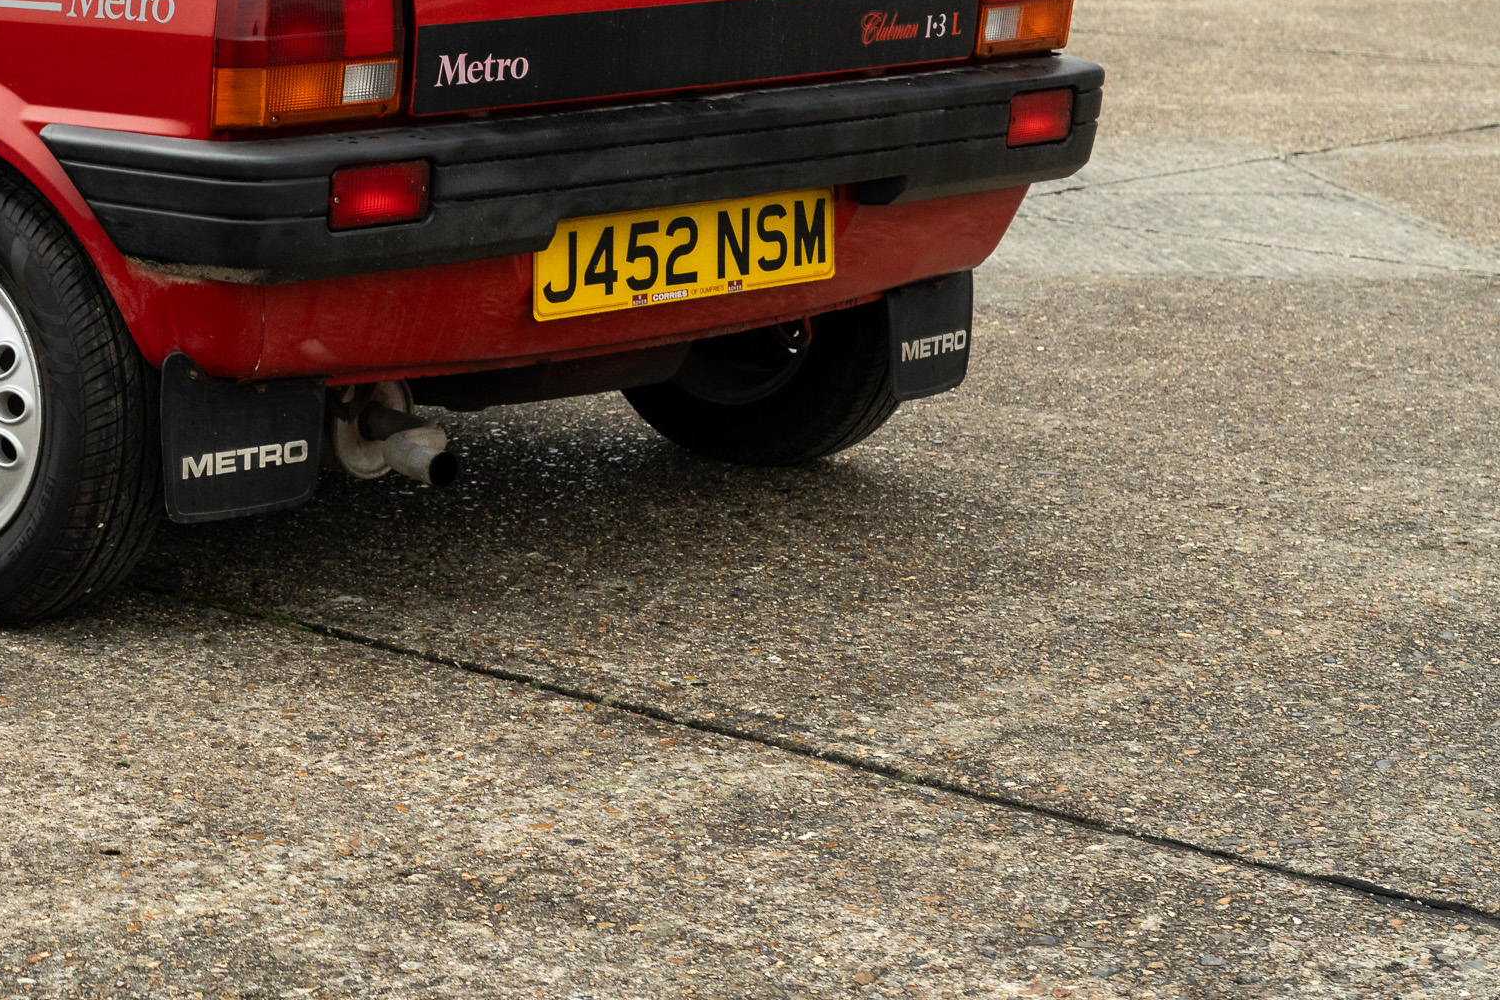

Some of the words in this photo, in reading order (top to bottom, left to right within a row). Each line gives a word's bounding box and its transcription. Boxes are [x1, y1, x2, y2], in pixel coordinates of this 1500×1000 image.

[861, 11, 919, 46] Clubman
[951, 12, 962, 36] L
[433, 52, 530, 88] Metro
[542, 216, 699, 304] J452
[717, 197, 827, 280] NSM
[652, 289, 688, 302] CORRIES
[691, 287, 699, 296] OF
[700, 284, 725, 295] DUMFRIES
[901, 329, 967, 363] METRO
[181, 439, 309, 480] METRO
